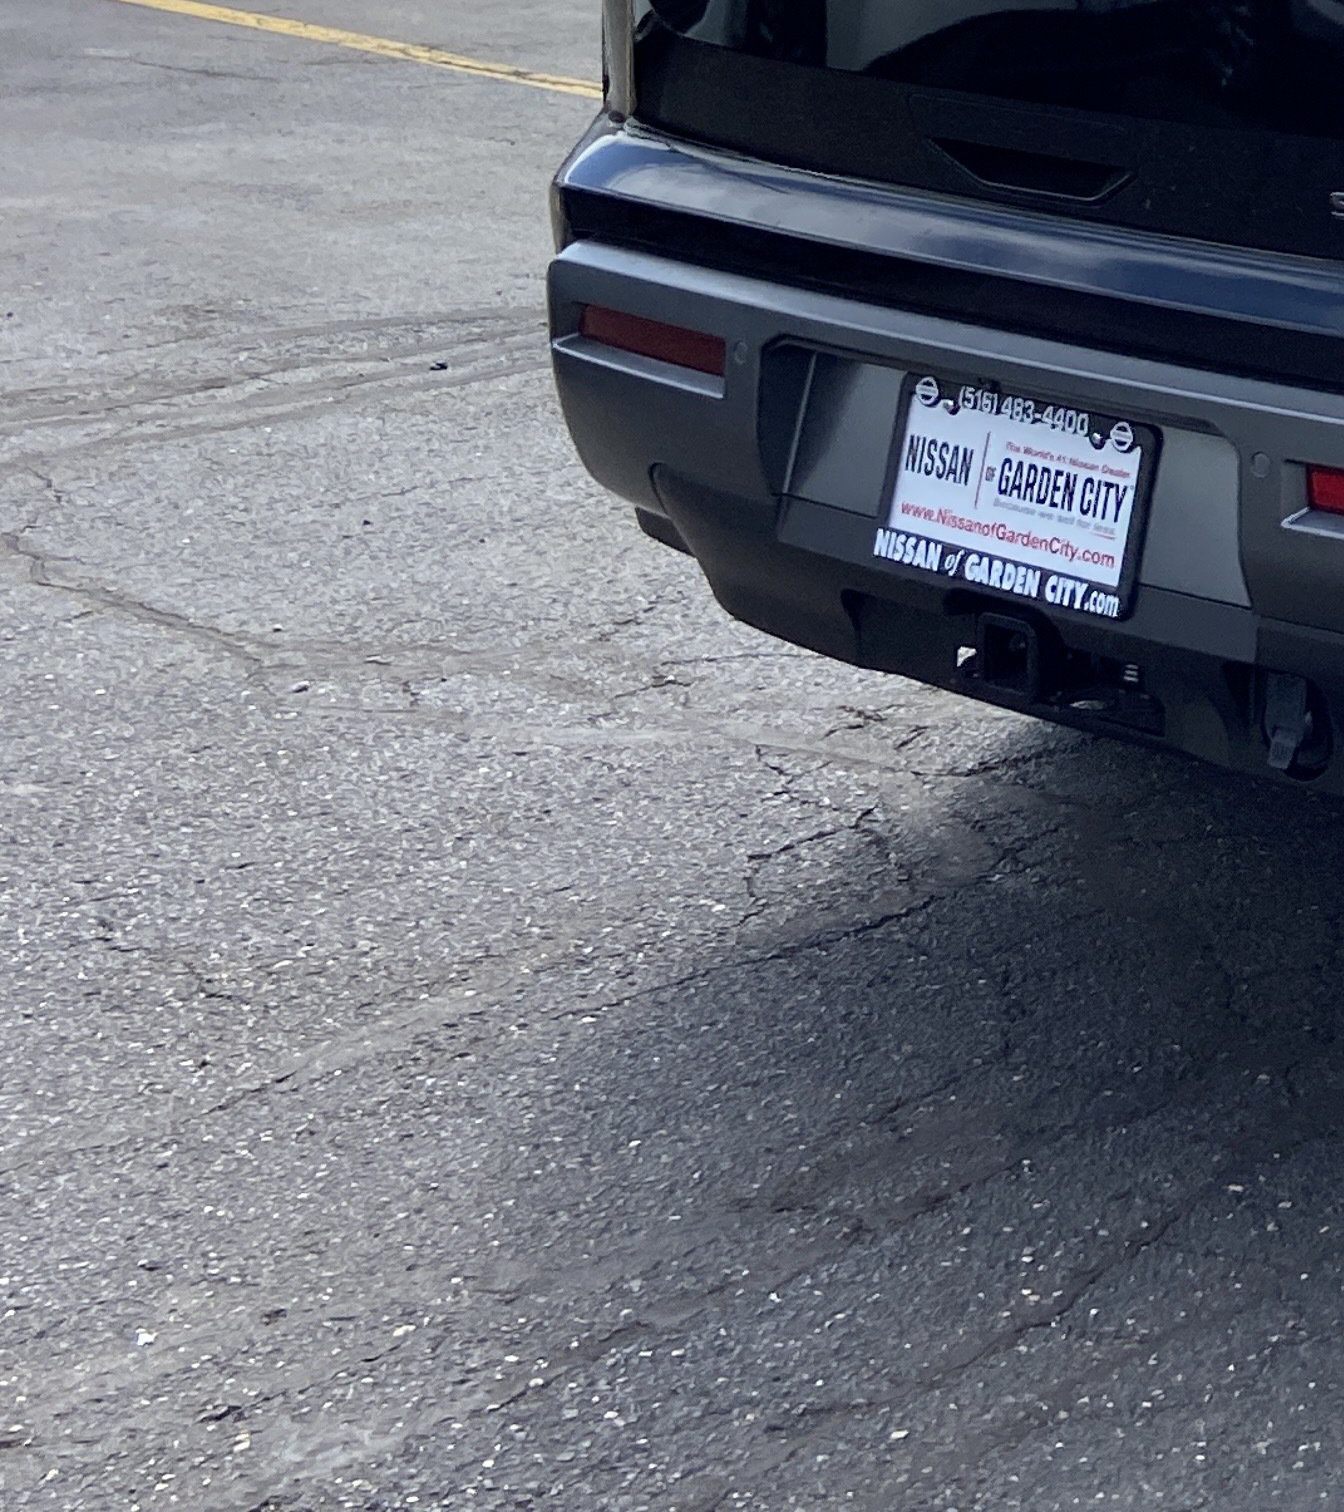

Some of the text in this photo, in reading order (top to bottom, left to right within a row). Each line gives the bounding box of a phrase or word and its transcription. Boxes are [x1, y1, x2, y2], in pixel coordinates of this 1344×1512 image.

[958, 385, 1090, 436] (516) 483-4400
[904, 434, 975, 487] NISSAN
[997, 456, 1079, 513] GARDEN
[1079, 475, 1129, 524] CITY
[900, 499, 1116, 569] www.NissanofGardenCity.com
[873, 527, 1120, 619] NISSAN of GARDEN CITY.com
